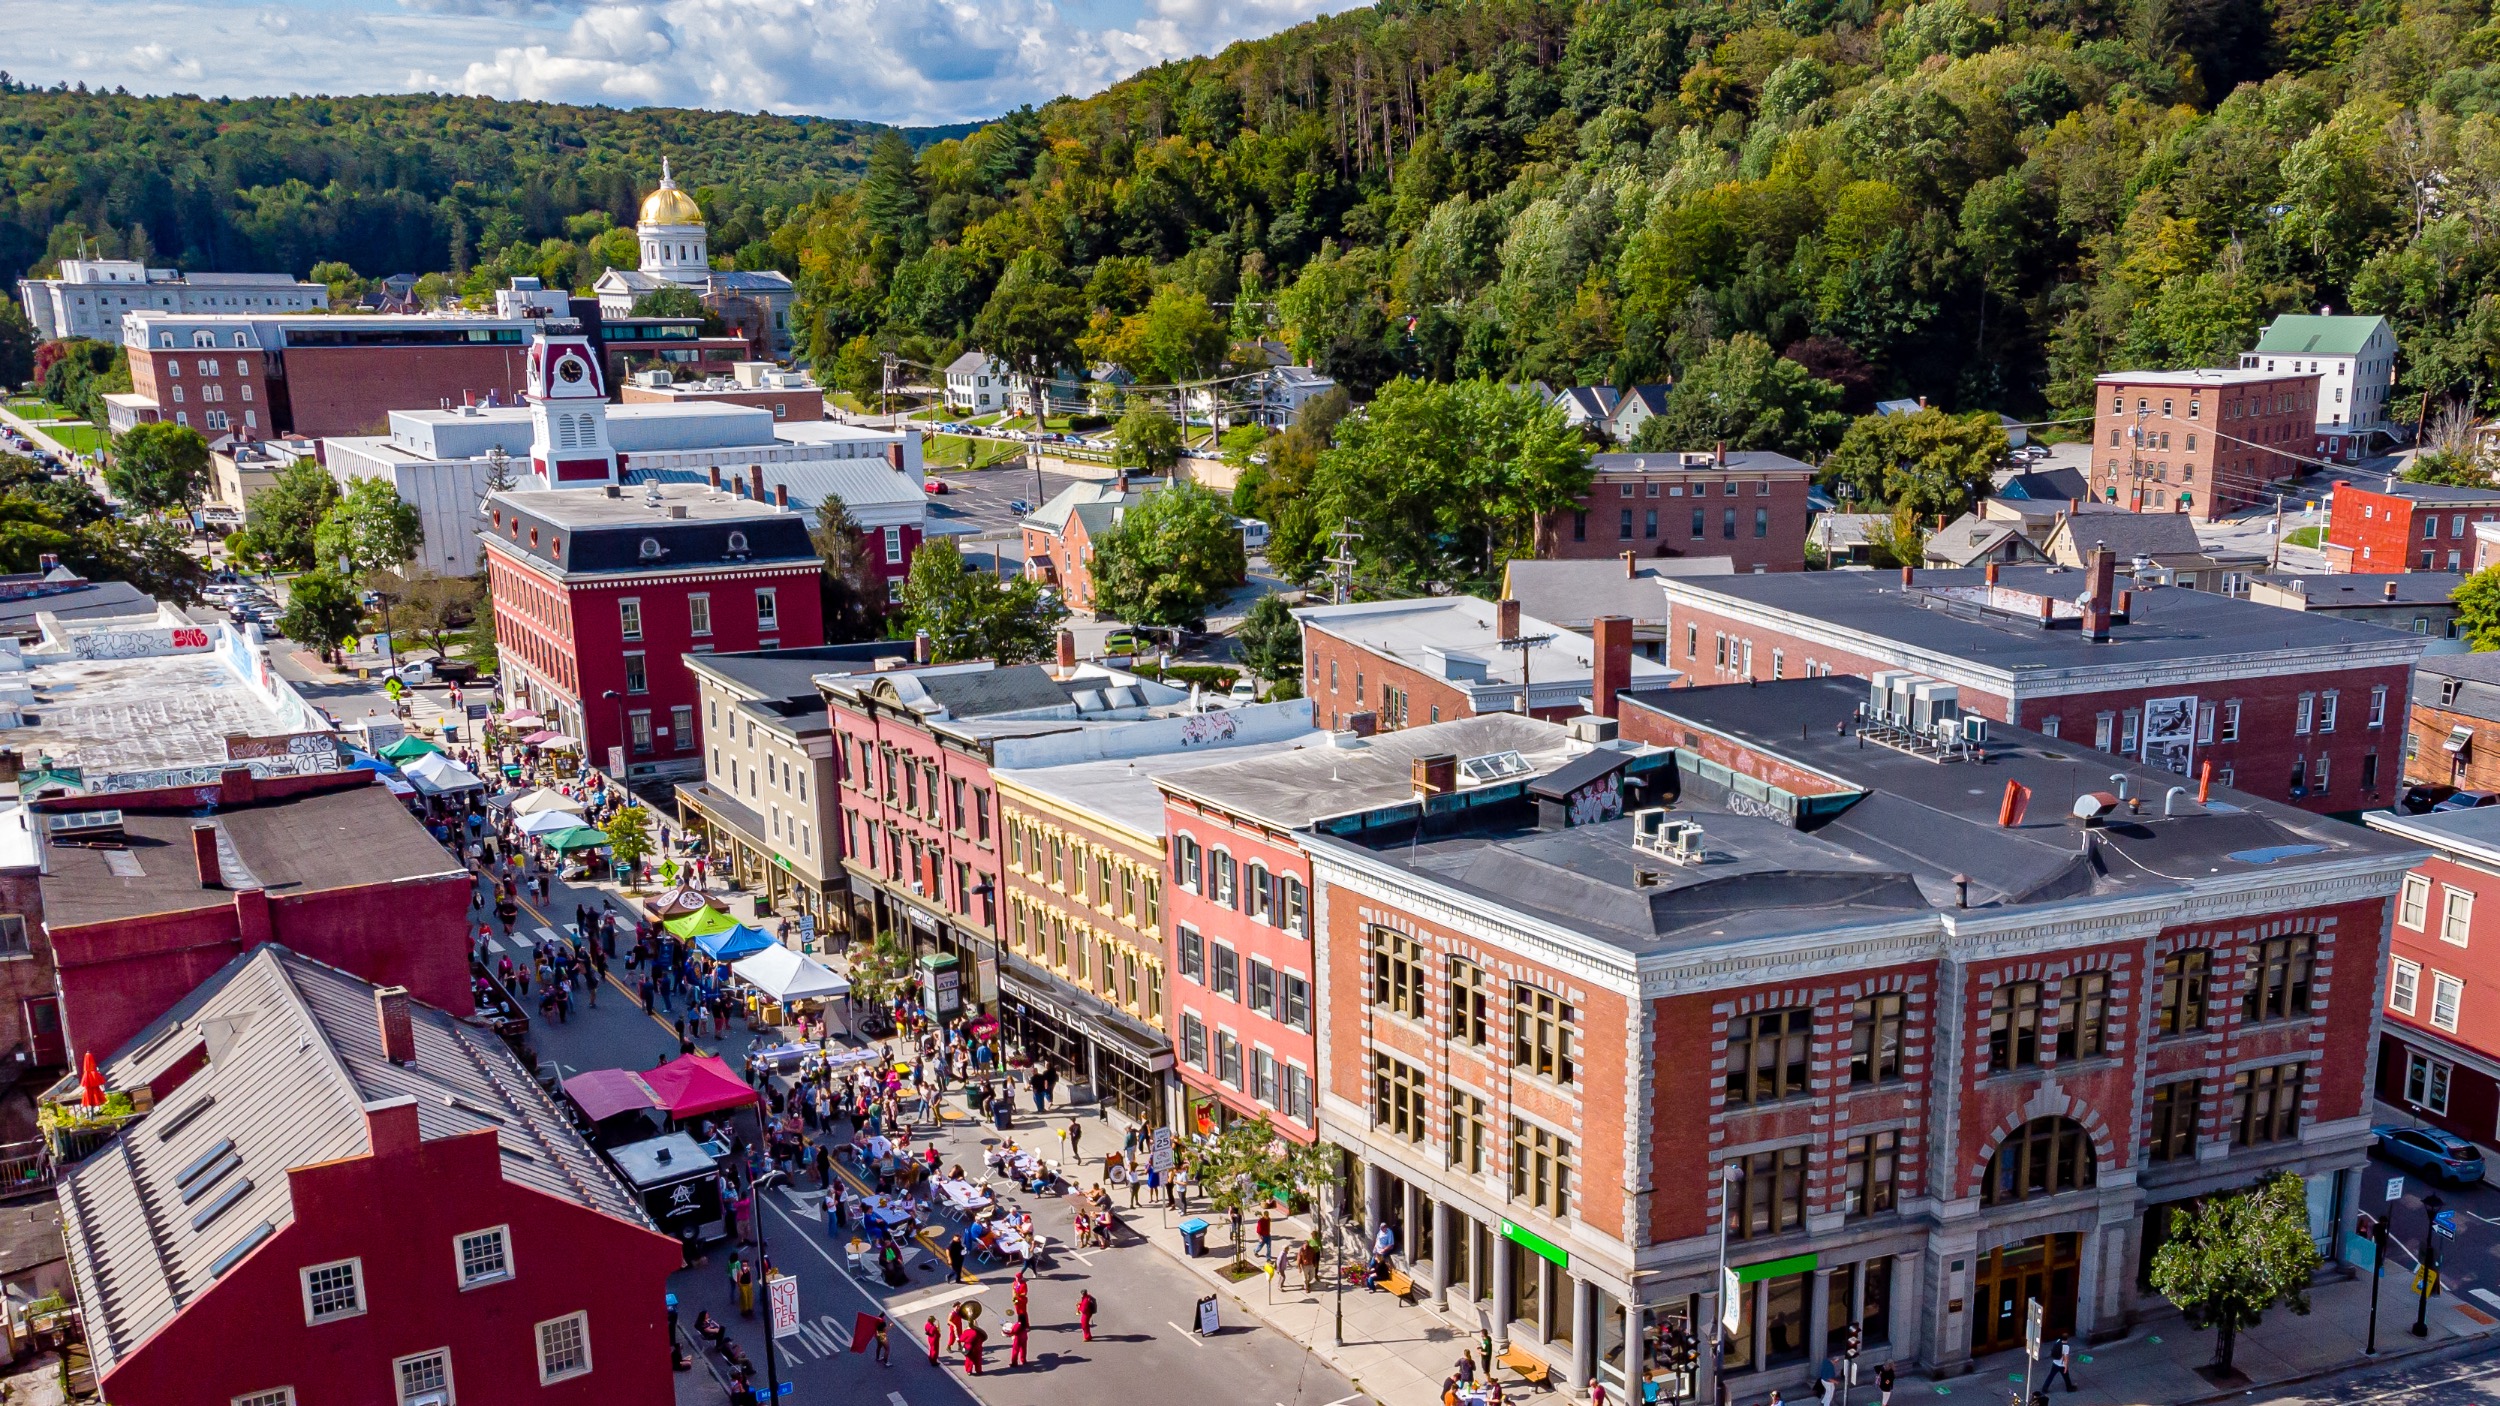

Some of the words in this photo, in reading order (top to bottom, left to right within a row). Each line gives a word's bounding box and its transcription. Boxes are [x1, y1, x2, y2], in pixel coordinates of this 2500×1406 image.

[804, 932, 811, 941] 2
[938, 979, 958, 990] ATM
[1156, 1138, 1170, 1148] 25
[1502, 1222, 1513, 1235] TD
